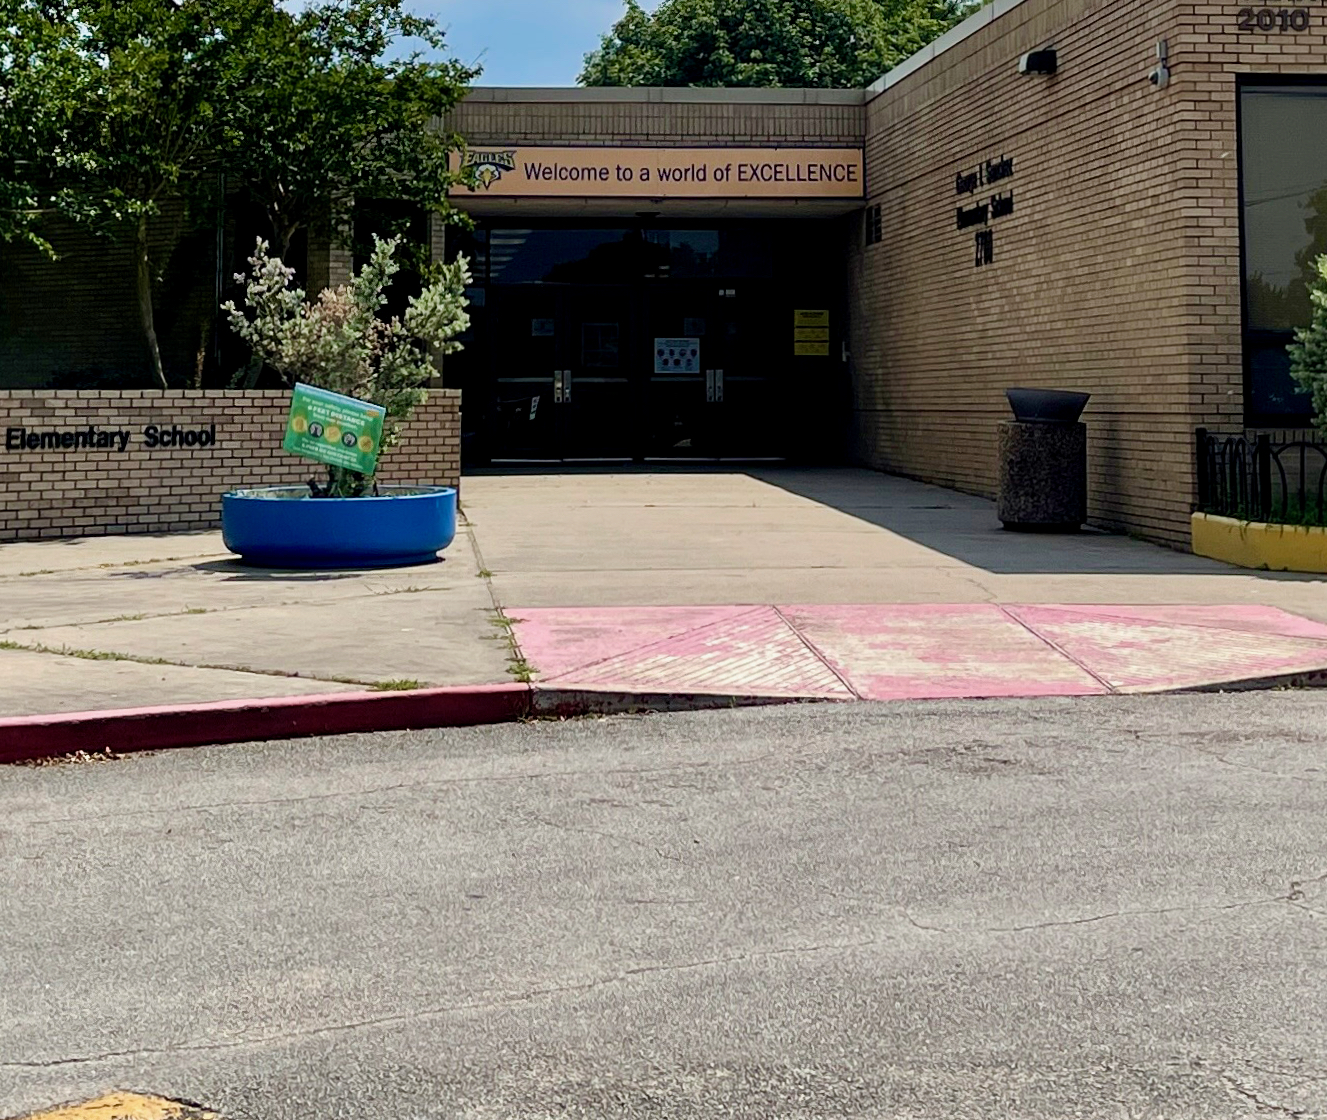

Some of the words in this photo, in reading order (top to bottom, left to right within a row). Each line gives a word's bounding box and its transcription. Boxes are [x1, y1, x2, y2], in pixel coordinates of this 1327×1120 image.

[1238, 8, 1309, 31] 2010
[466, 153, 514, 170] EAGLES
[524, 162, 610, 181] Welcome
[616, 164, 634, 181] to
[639, 166, 650, 181] a
[657, 163, 707, 182] world
[713, 163, 732, 182] of
[737, 163, 858, 182] EXCELLENCE
[6, 427, 130, 452] Elementary
[144, 424, 216, 447] School
